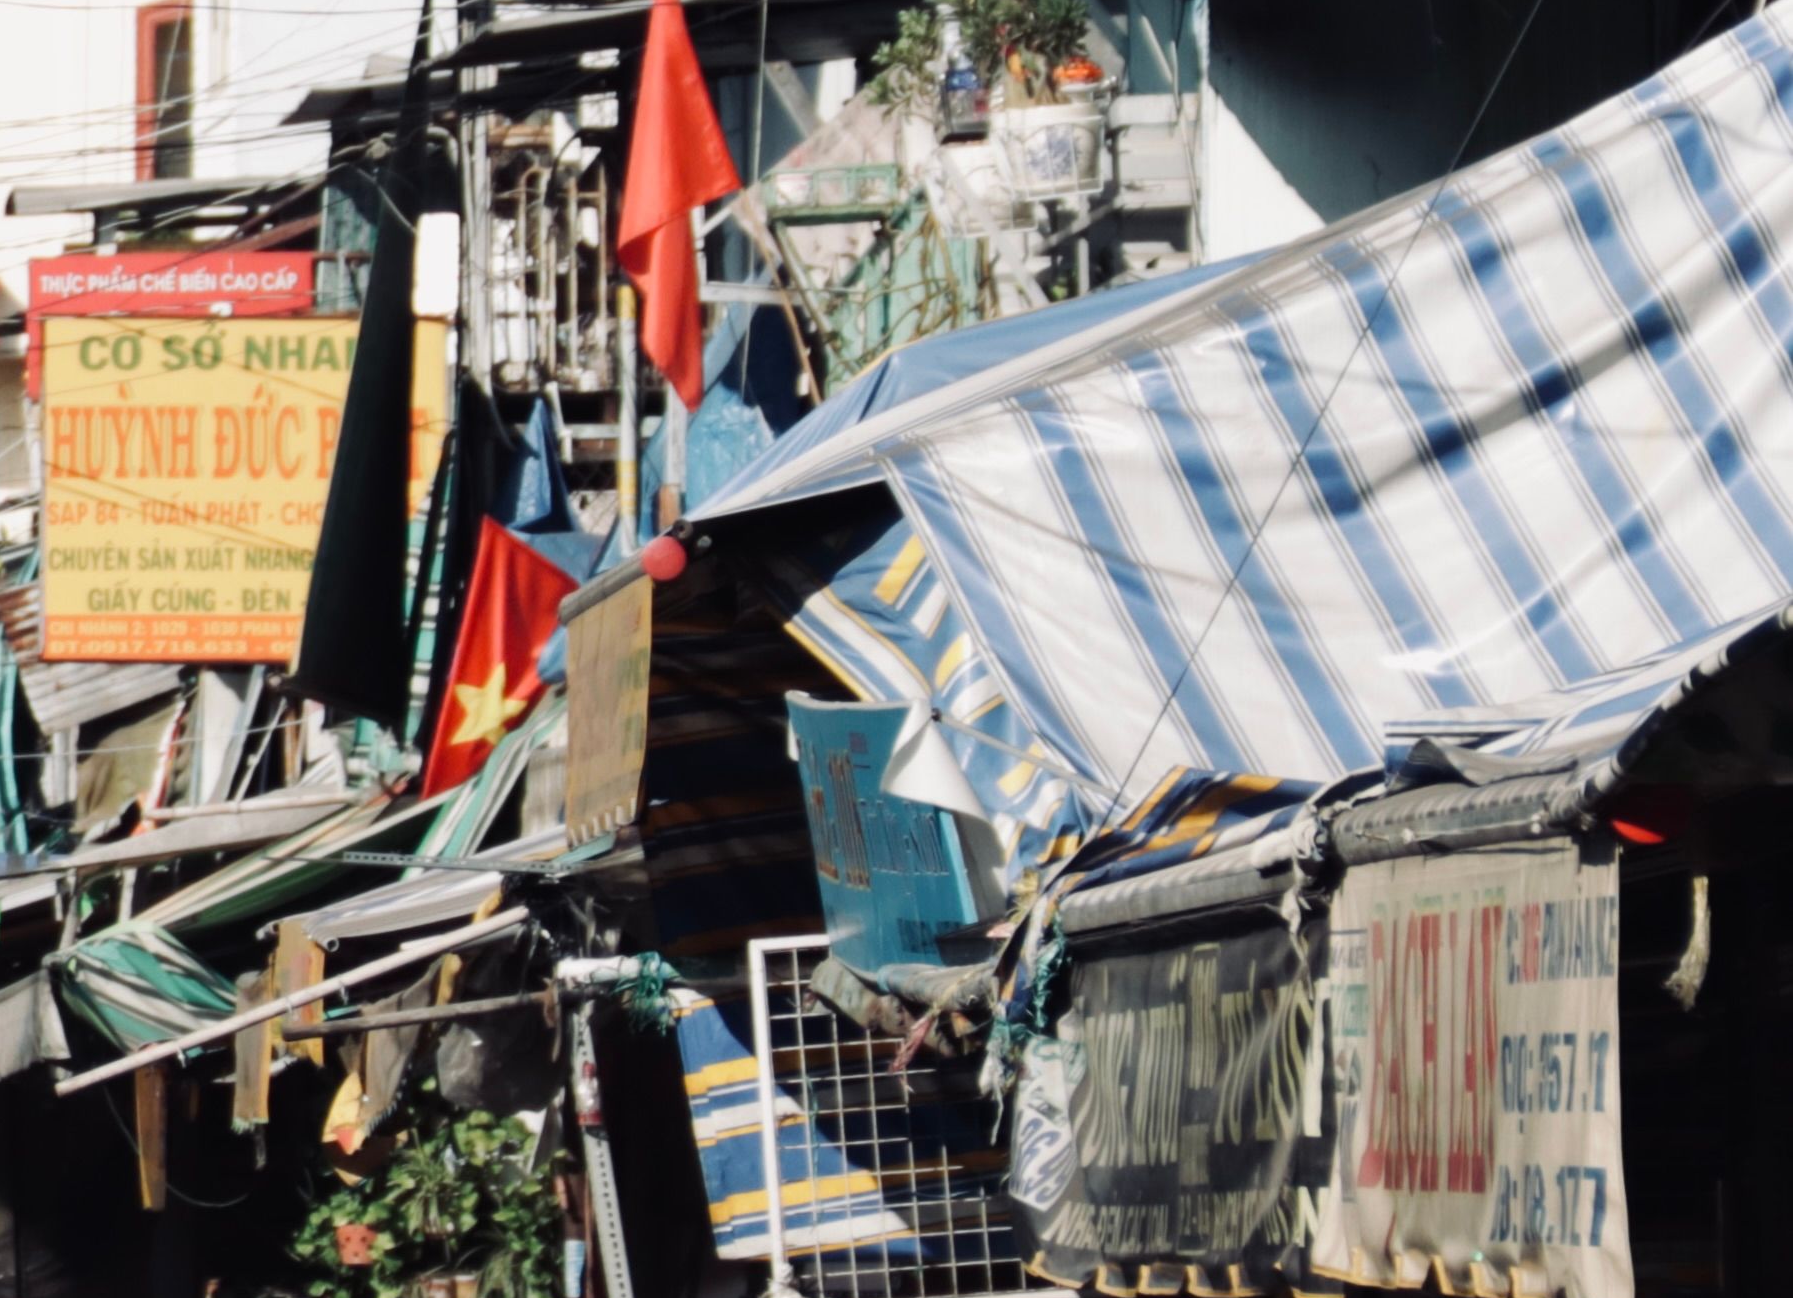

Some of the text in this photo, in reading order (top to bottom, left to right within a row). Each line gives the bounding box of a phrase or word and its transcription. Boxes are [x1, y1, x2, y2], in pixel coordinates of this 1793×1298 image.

[50, 383, 197, 480] HUỲNH
[214, 383, 304, 480] ĐỨC
[87, 579, 142, 613] GIẤY
[241, 581, 291, 613] ĐÈN
